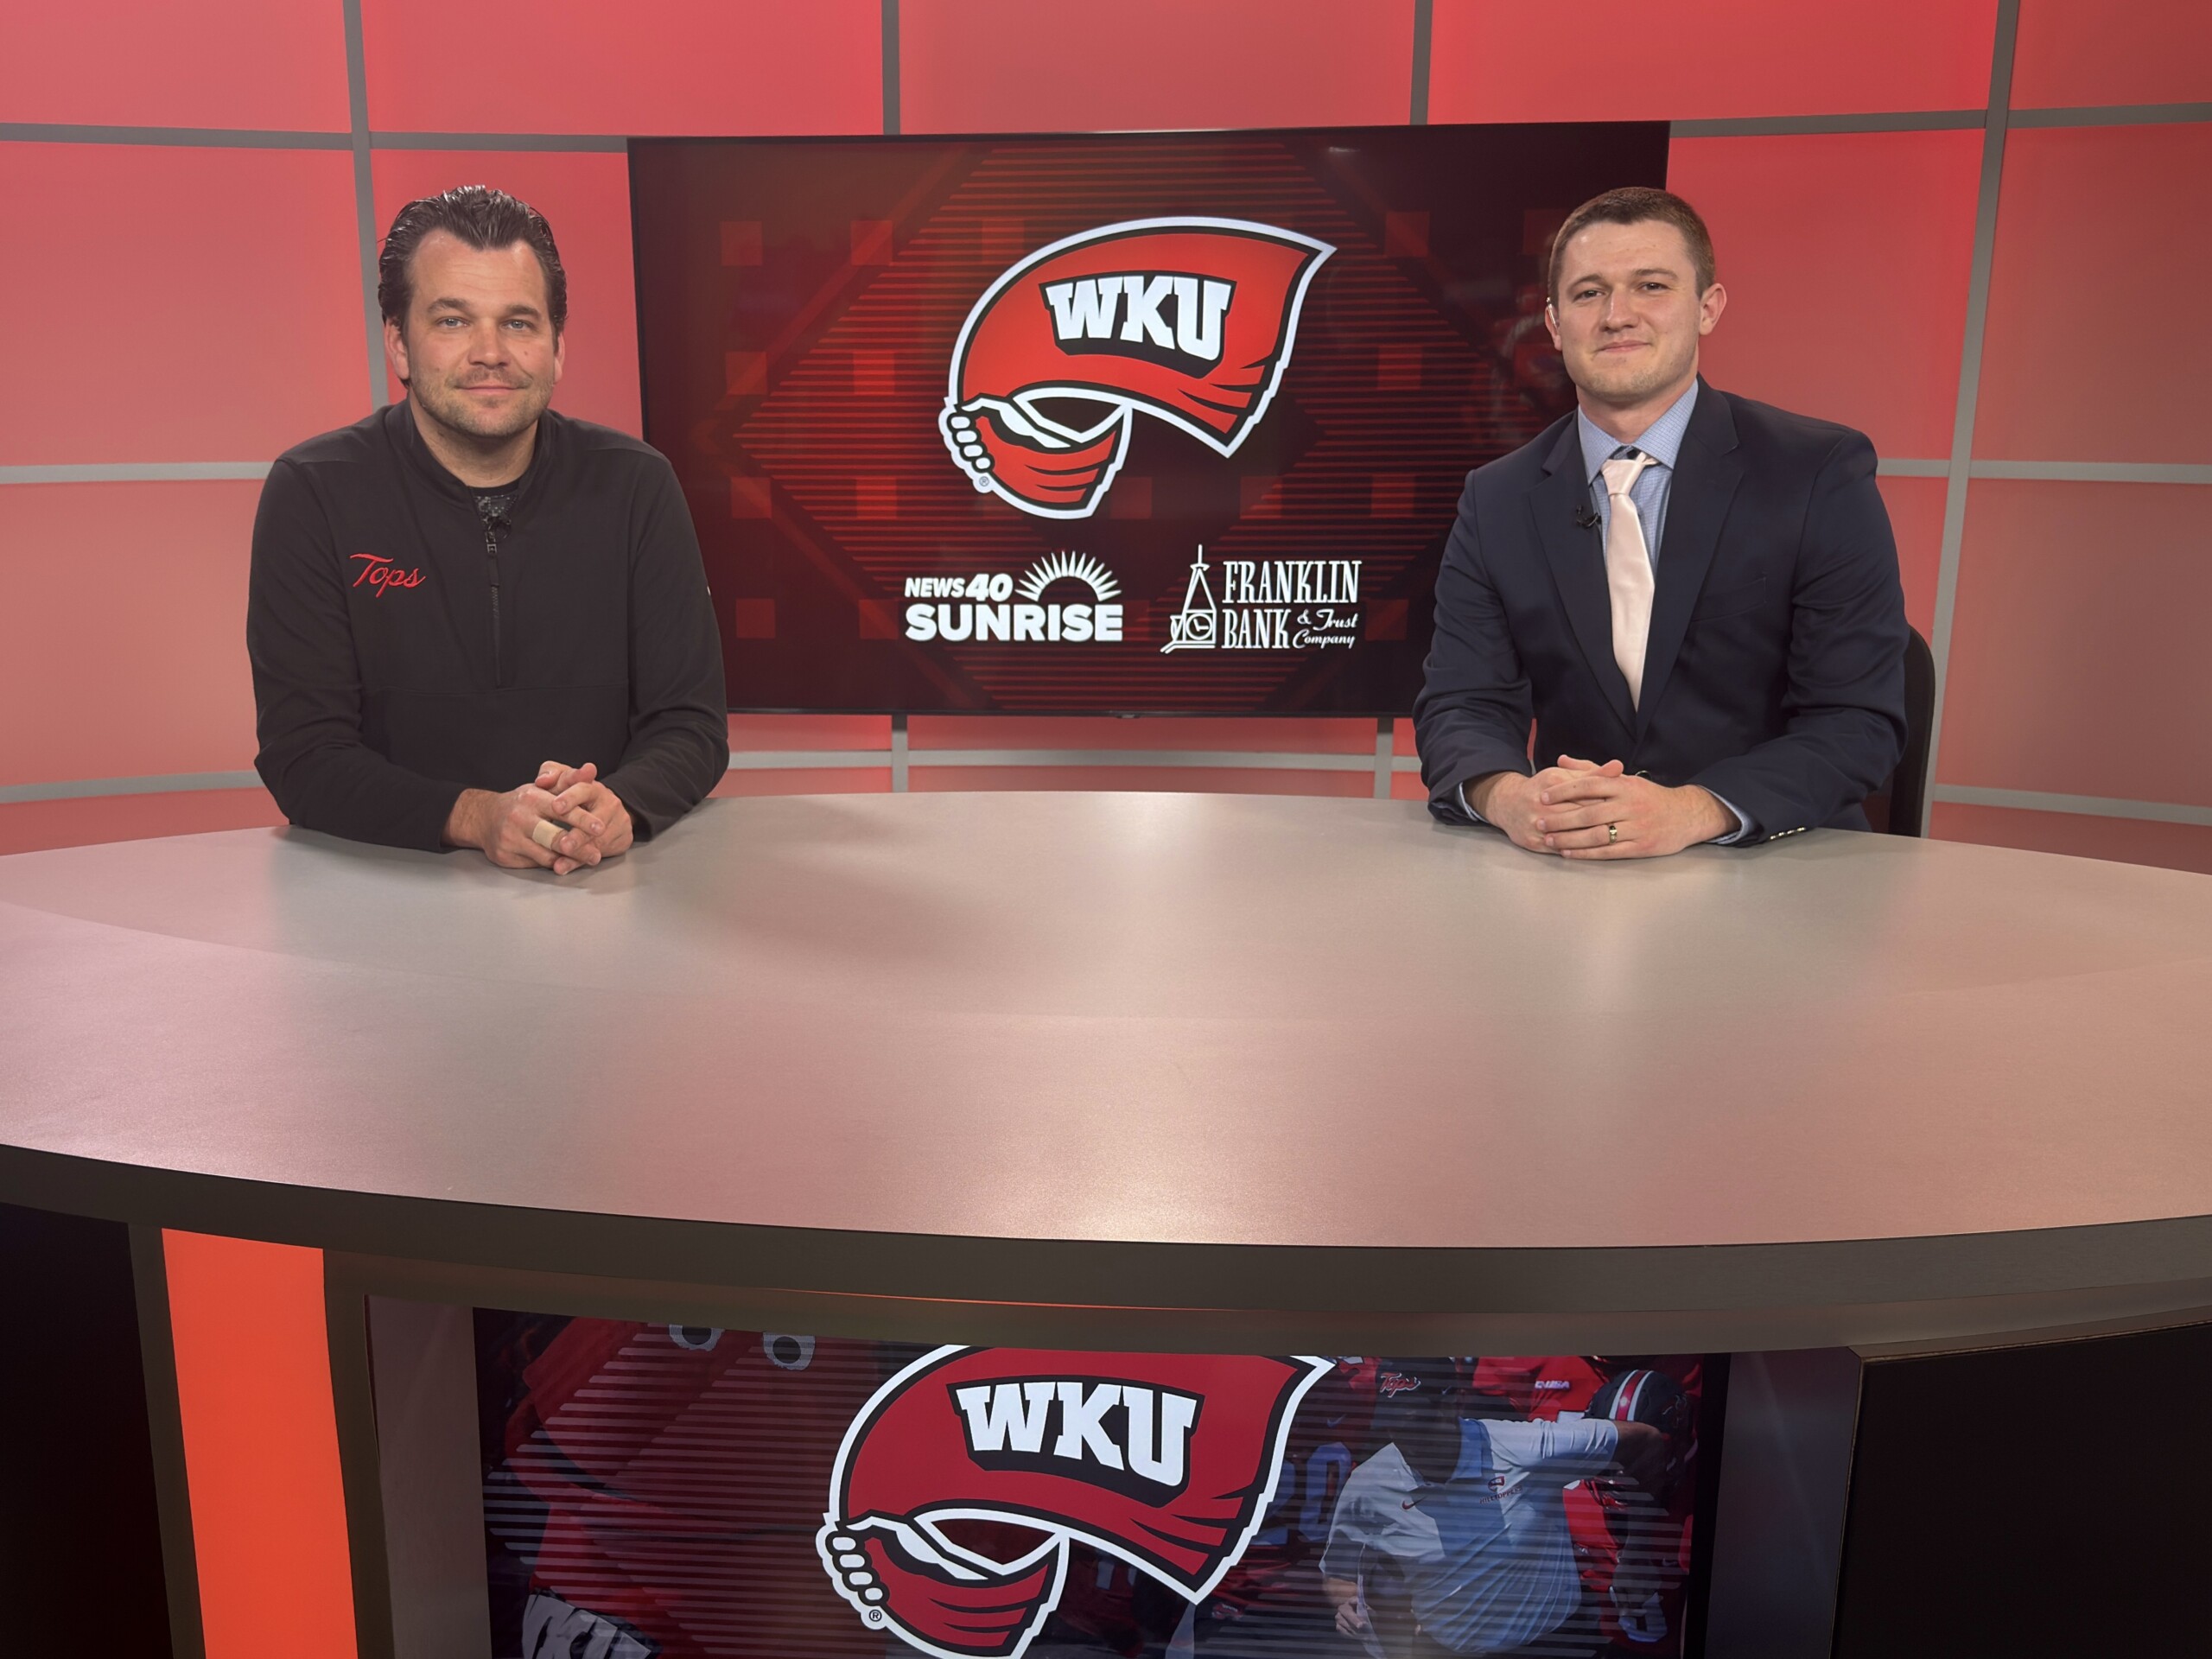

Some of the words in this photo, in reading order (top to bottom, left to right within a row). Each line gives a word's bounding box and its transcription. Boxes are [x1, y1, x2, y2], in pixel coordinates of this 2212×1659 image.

[1045, 275, 1232, 361] WKU
[349, 553, 427, 598] Tops
[1222, 560, 1363, 604] FRANKLIN
[905, 603, 1123, 642] SUNRISE
[1221, 608, 1292, 649] BANK
[1292, 628, 1356, 650] Company
[1296, 608, 1313, 625] &
[1313, 608, 1359, 632] Trust
[1379, 1372, 1421, 1398] Tops
[955, 1381, 1198, 1487] WKU
